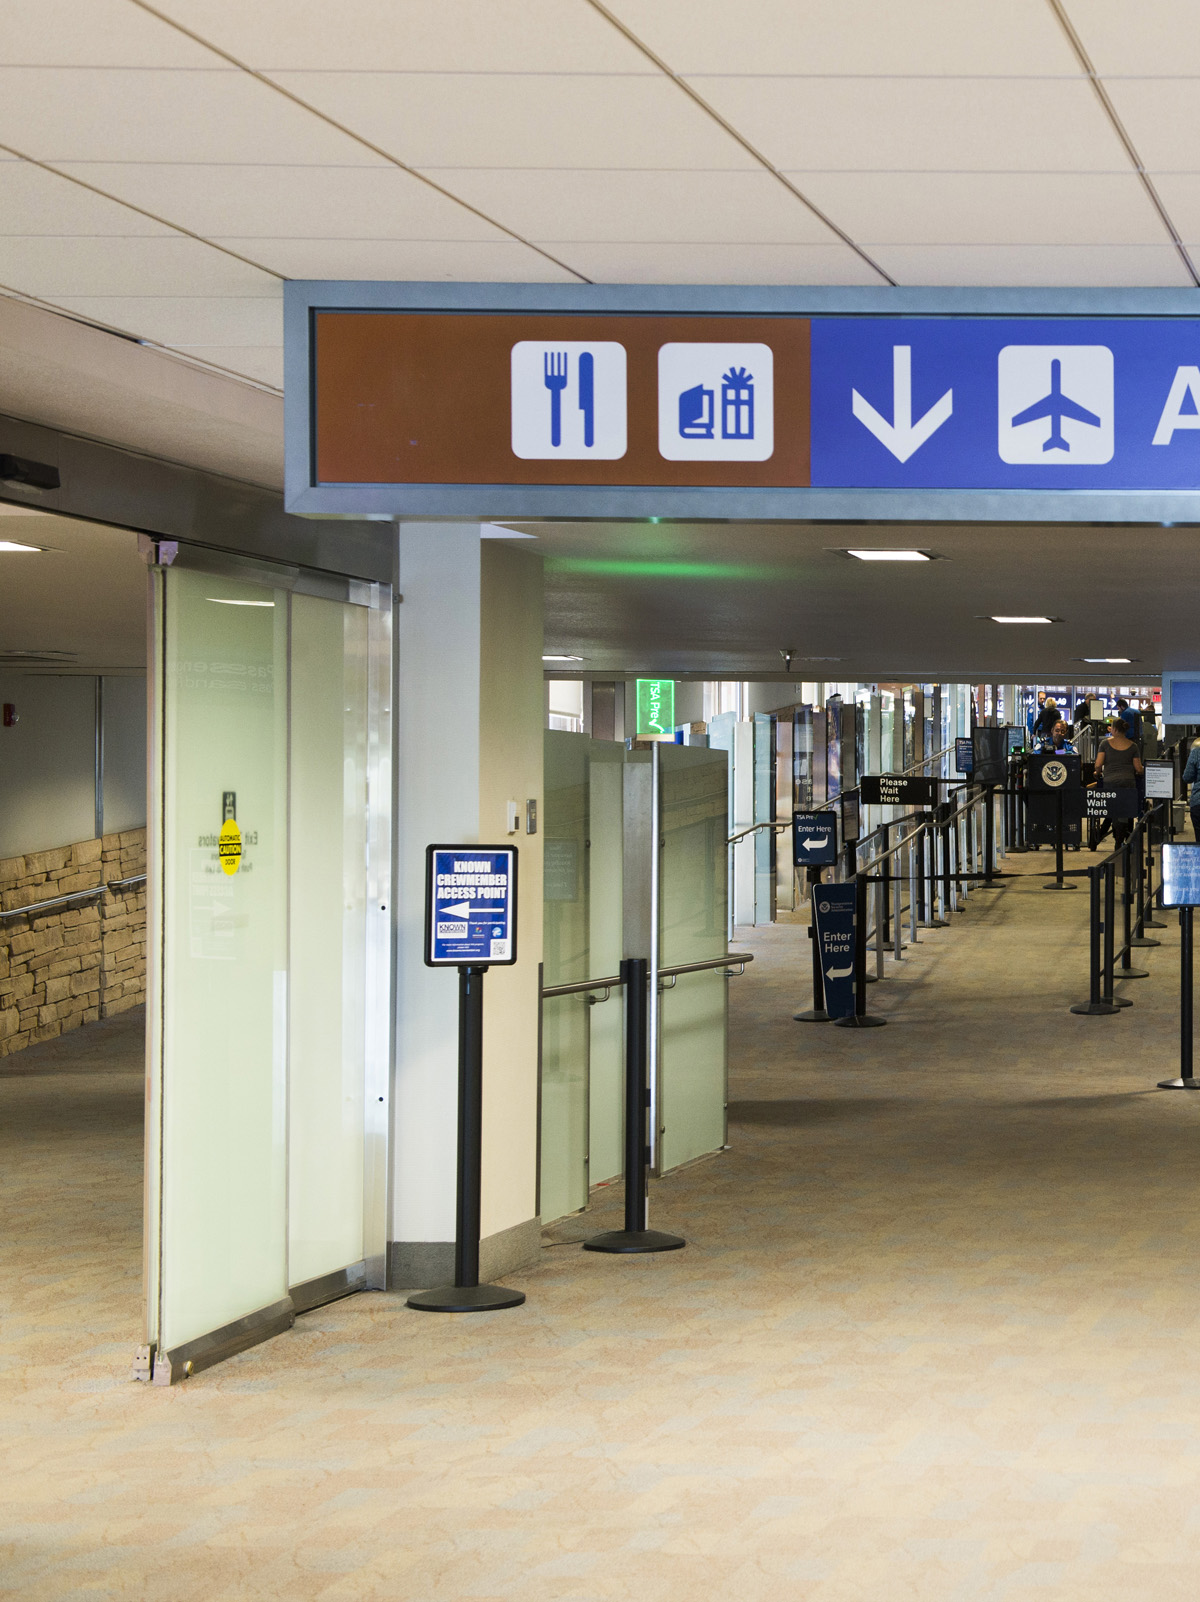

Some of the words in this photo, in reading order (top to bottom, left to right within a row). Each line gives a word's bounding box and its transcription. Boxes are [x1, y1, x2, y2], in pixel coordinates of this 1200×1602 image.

[650, 681, 661, 701] TSA
[650, 702, 661, 719] Pre
[880, 778, 908, 786] Please
[880, 786, 899, 794] Wait
[1086, 790, 1117, 798] Please
[880, 794, 900, 802] Here
[1086, 799, 1107, 807] Wait
[1087, 808, 1108, 816] Here
[816, 825, 832, 833] Here
[219, 844, 241, 856] CAUTION
[454, 861, 491, 873] KNOWN
[437, 874, 507, 886] CREWMEMBER
[437, 887, 476, 899] ACCESS
[477, 887, 507, 899] POINT
[823, 932, 851, 942] Enter
[825, 943, 850, 953] Here
